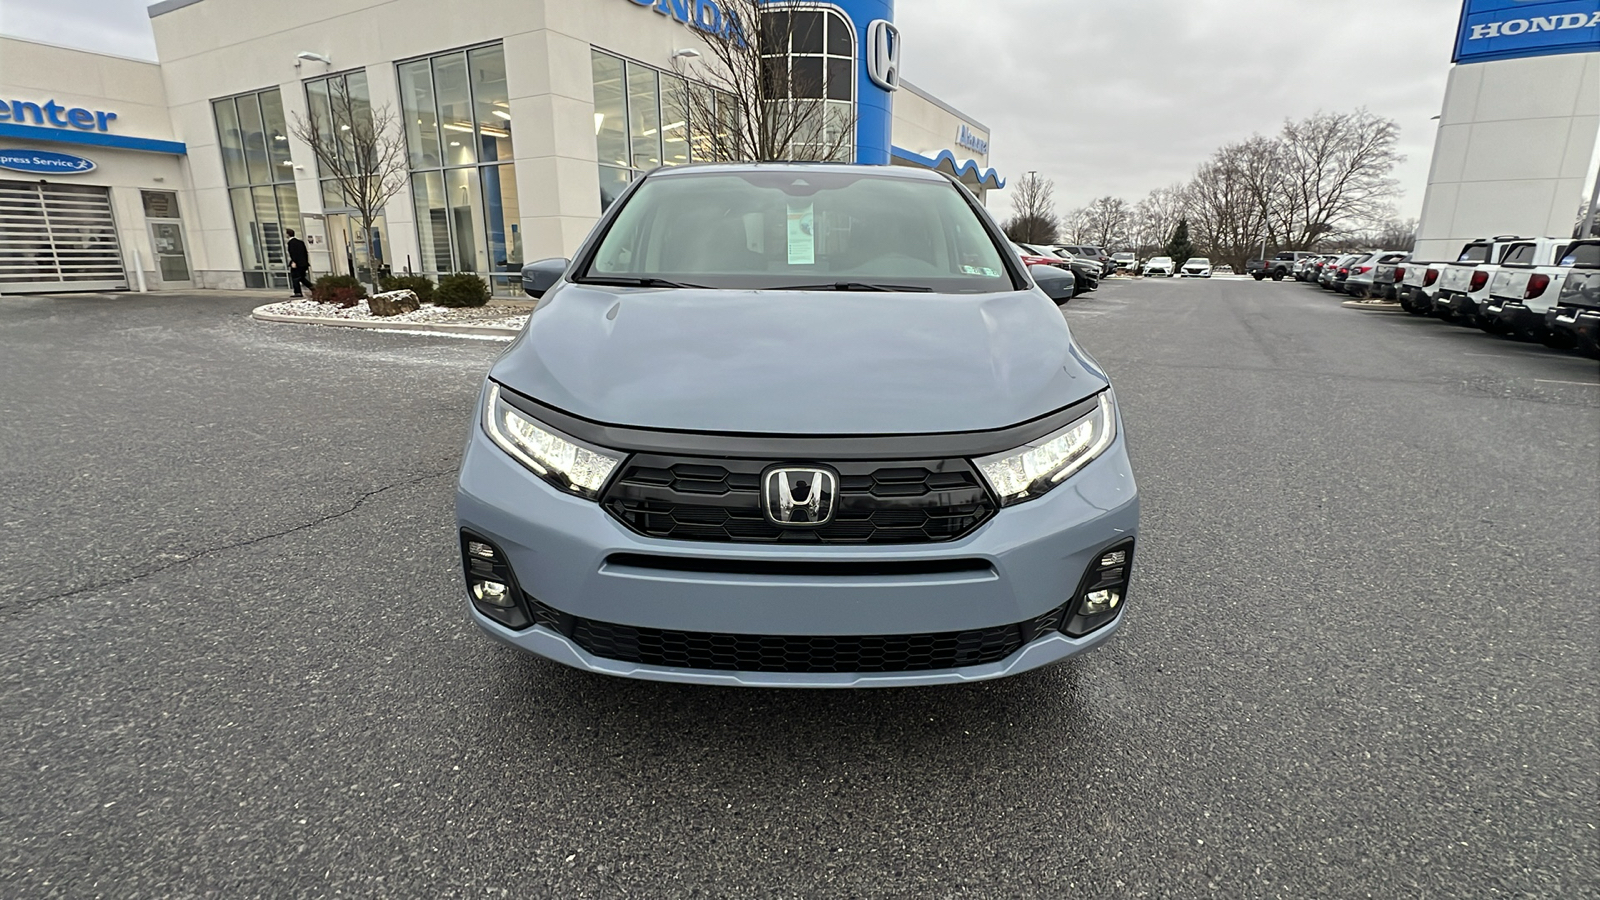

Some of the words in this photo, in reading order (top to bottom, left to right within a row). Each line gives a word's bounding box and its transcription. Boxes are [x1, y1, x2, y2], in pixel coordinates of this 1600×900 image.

[626, 0, 746, 49] NDA
[0, 156, 30, 164] press
[33, 156, 74, 167] Service
